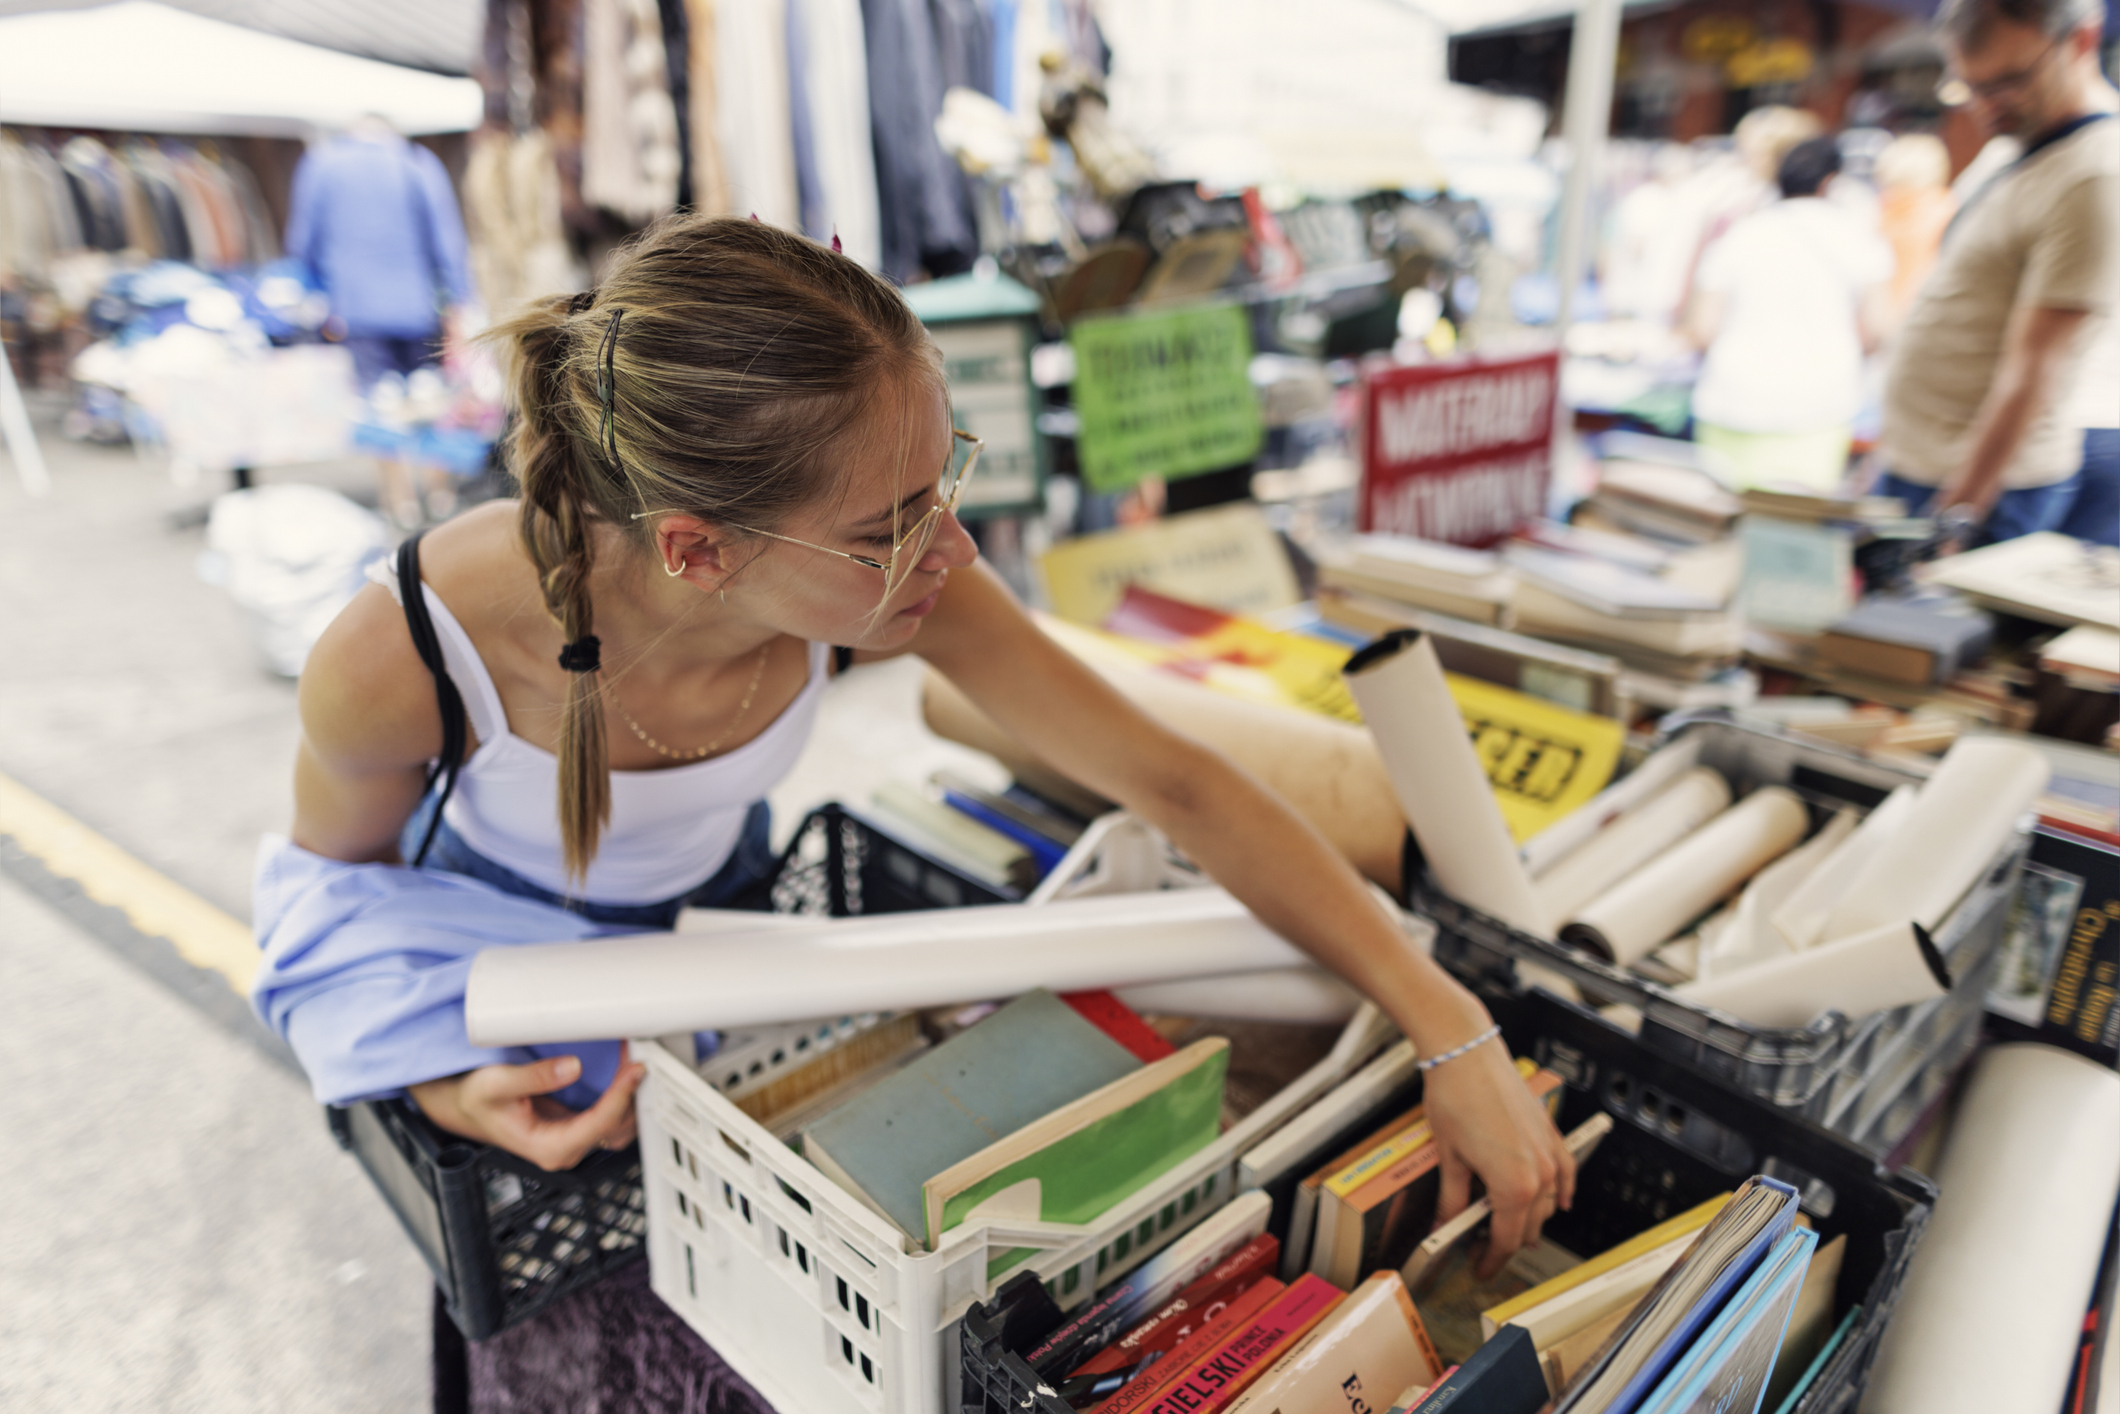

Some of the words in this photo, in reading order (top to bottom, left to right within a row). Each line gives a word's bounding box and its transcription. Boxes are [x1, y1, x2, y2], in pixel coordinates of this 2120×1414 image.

[1026, 1341, 1052, 1363] Polski
[1228, 1324, 1267, 1355] PRINCE
[1242, 1327, 1287, 1362] POLONIA
[1099, 1374, 1159, 1414] IDORSKI
